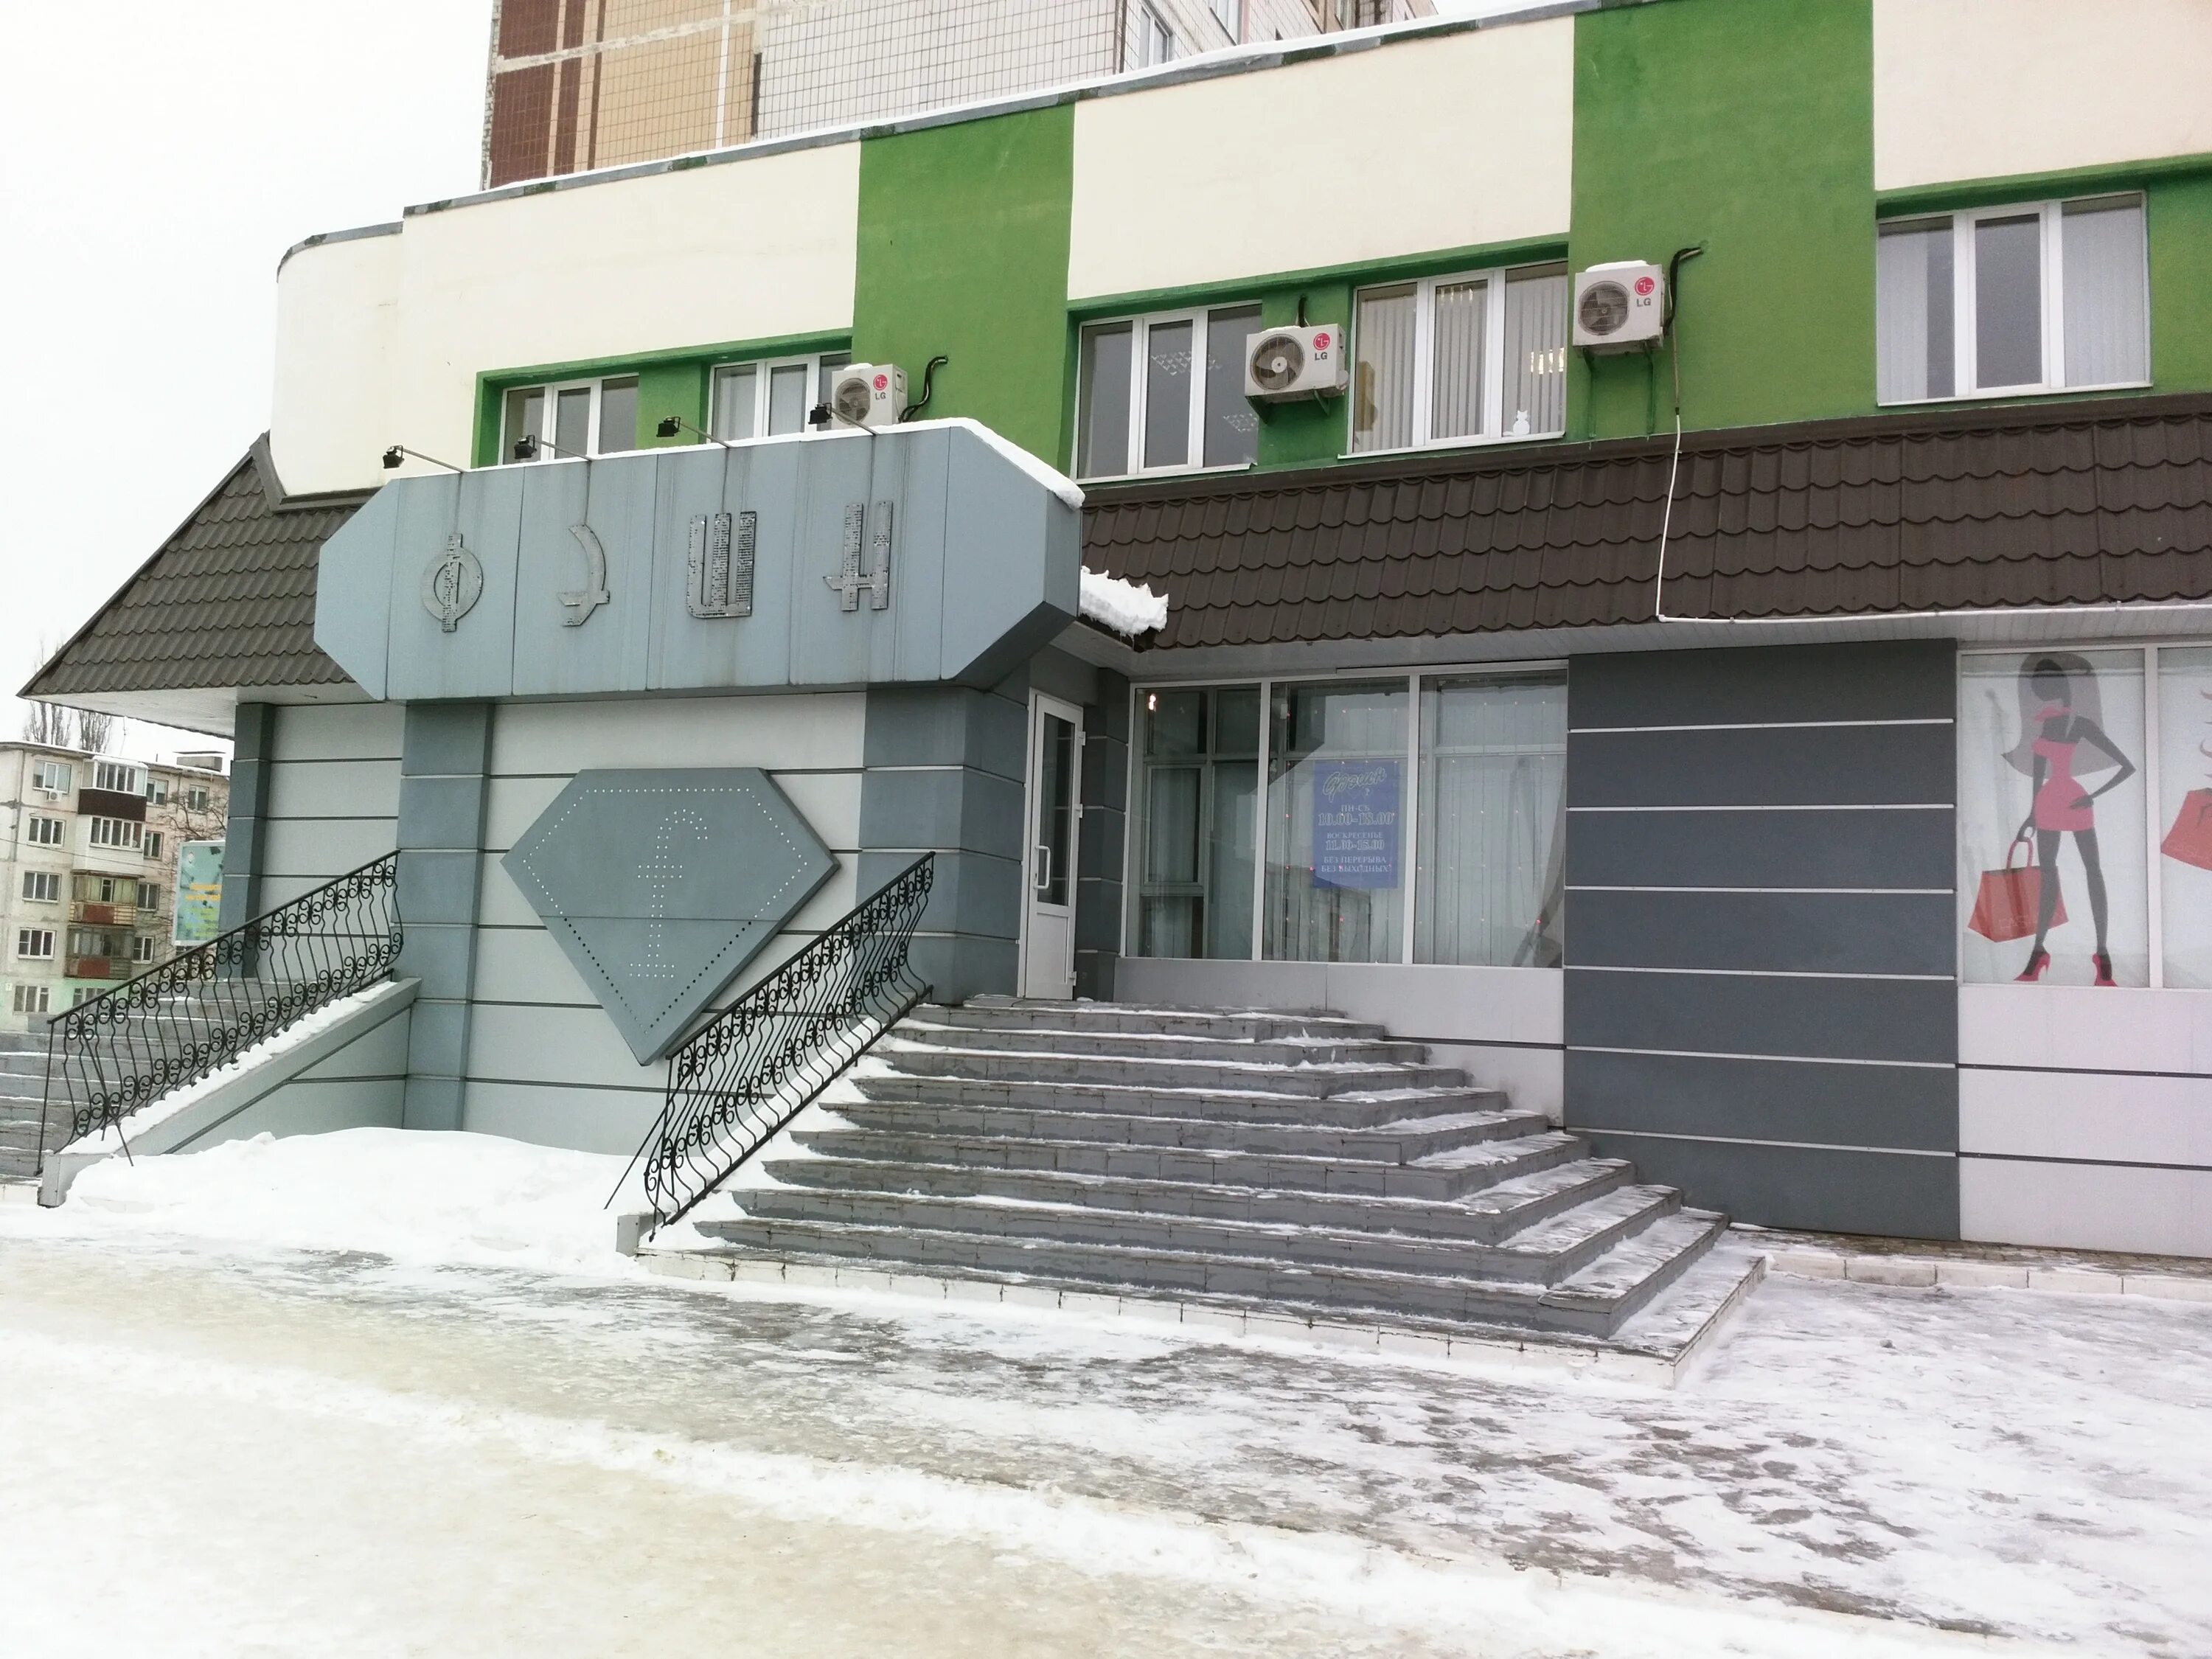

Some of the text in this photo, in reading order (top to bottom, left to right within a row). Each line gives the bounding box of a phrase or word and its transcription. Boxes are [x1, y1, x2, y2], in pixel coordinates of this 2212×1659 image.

[1636, 297, 1652, 307] LG
[1315, 352, 1328, 361] LG
[875, 392, 886, 400] LG
